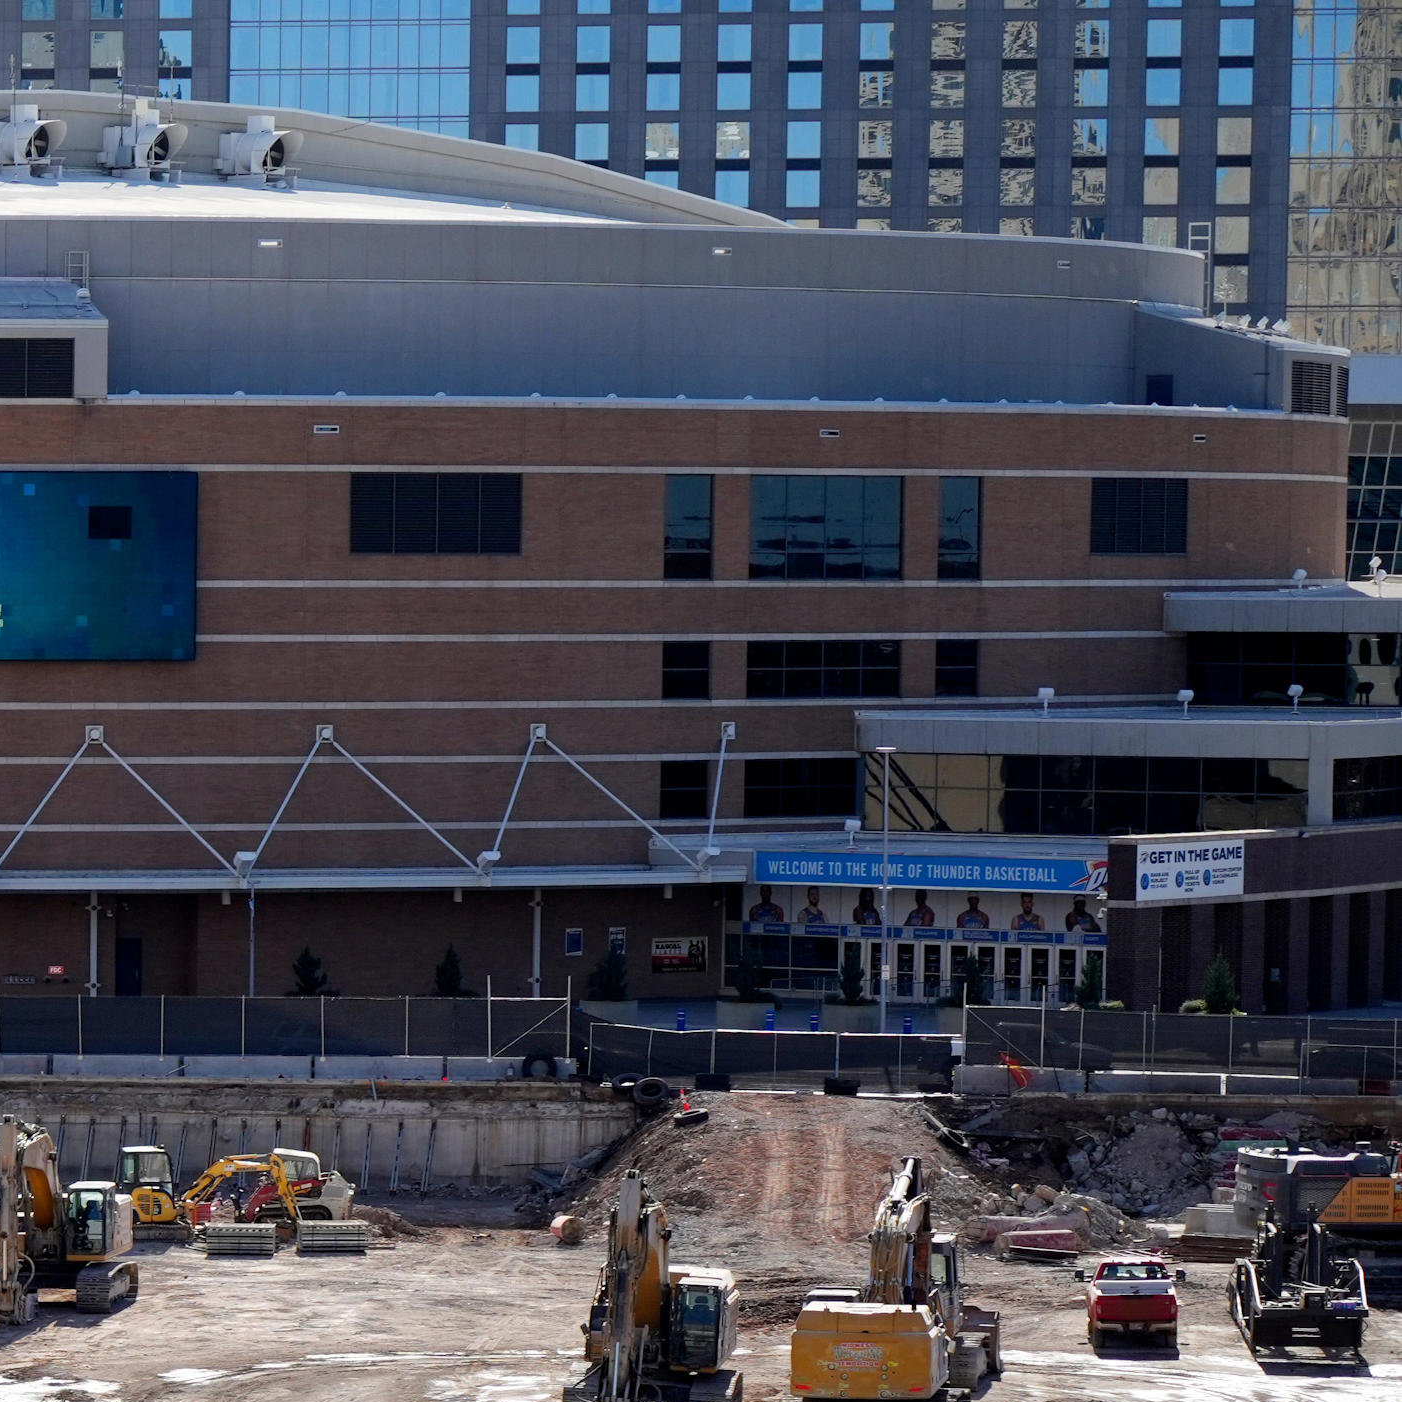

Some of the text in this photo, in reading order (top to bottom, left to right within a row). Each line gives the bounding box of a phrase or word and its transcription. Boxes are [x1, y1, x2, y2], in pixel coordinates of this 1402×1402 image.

[1149, 846, 1243, 864] GET IN THE GAME
[768, 860, 824, 876] WELCOME
[828, 861, 842, 876] TO
[846, 862, 867, 877] THE
[907, 864, 923, 878] OF
[926, 864, 981, 880] THUNDER
[985, 865, 1057, 882] BASKETBALL
